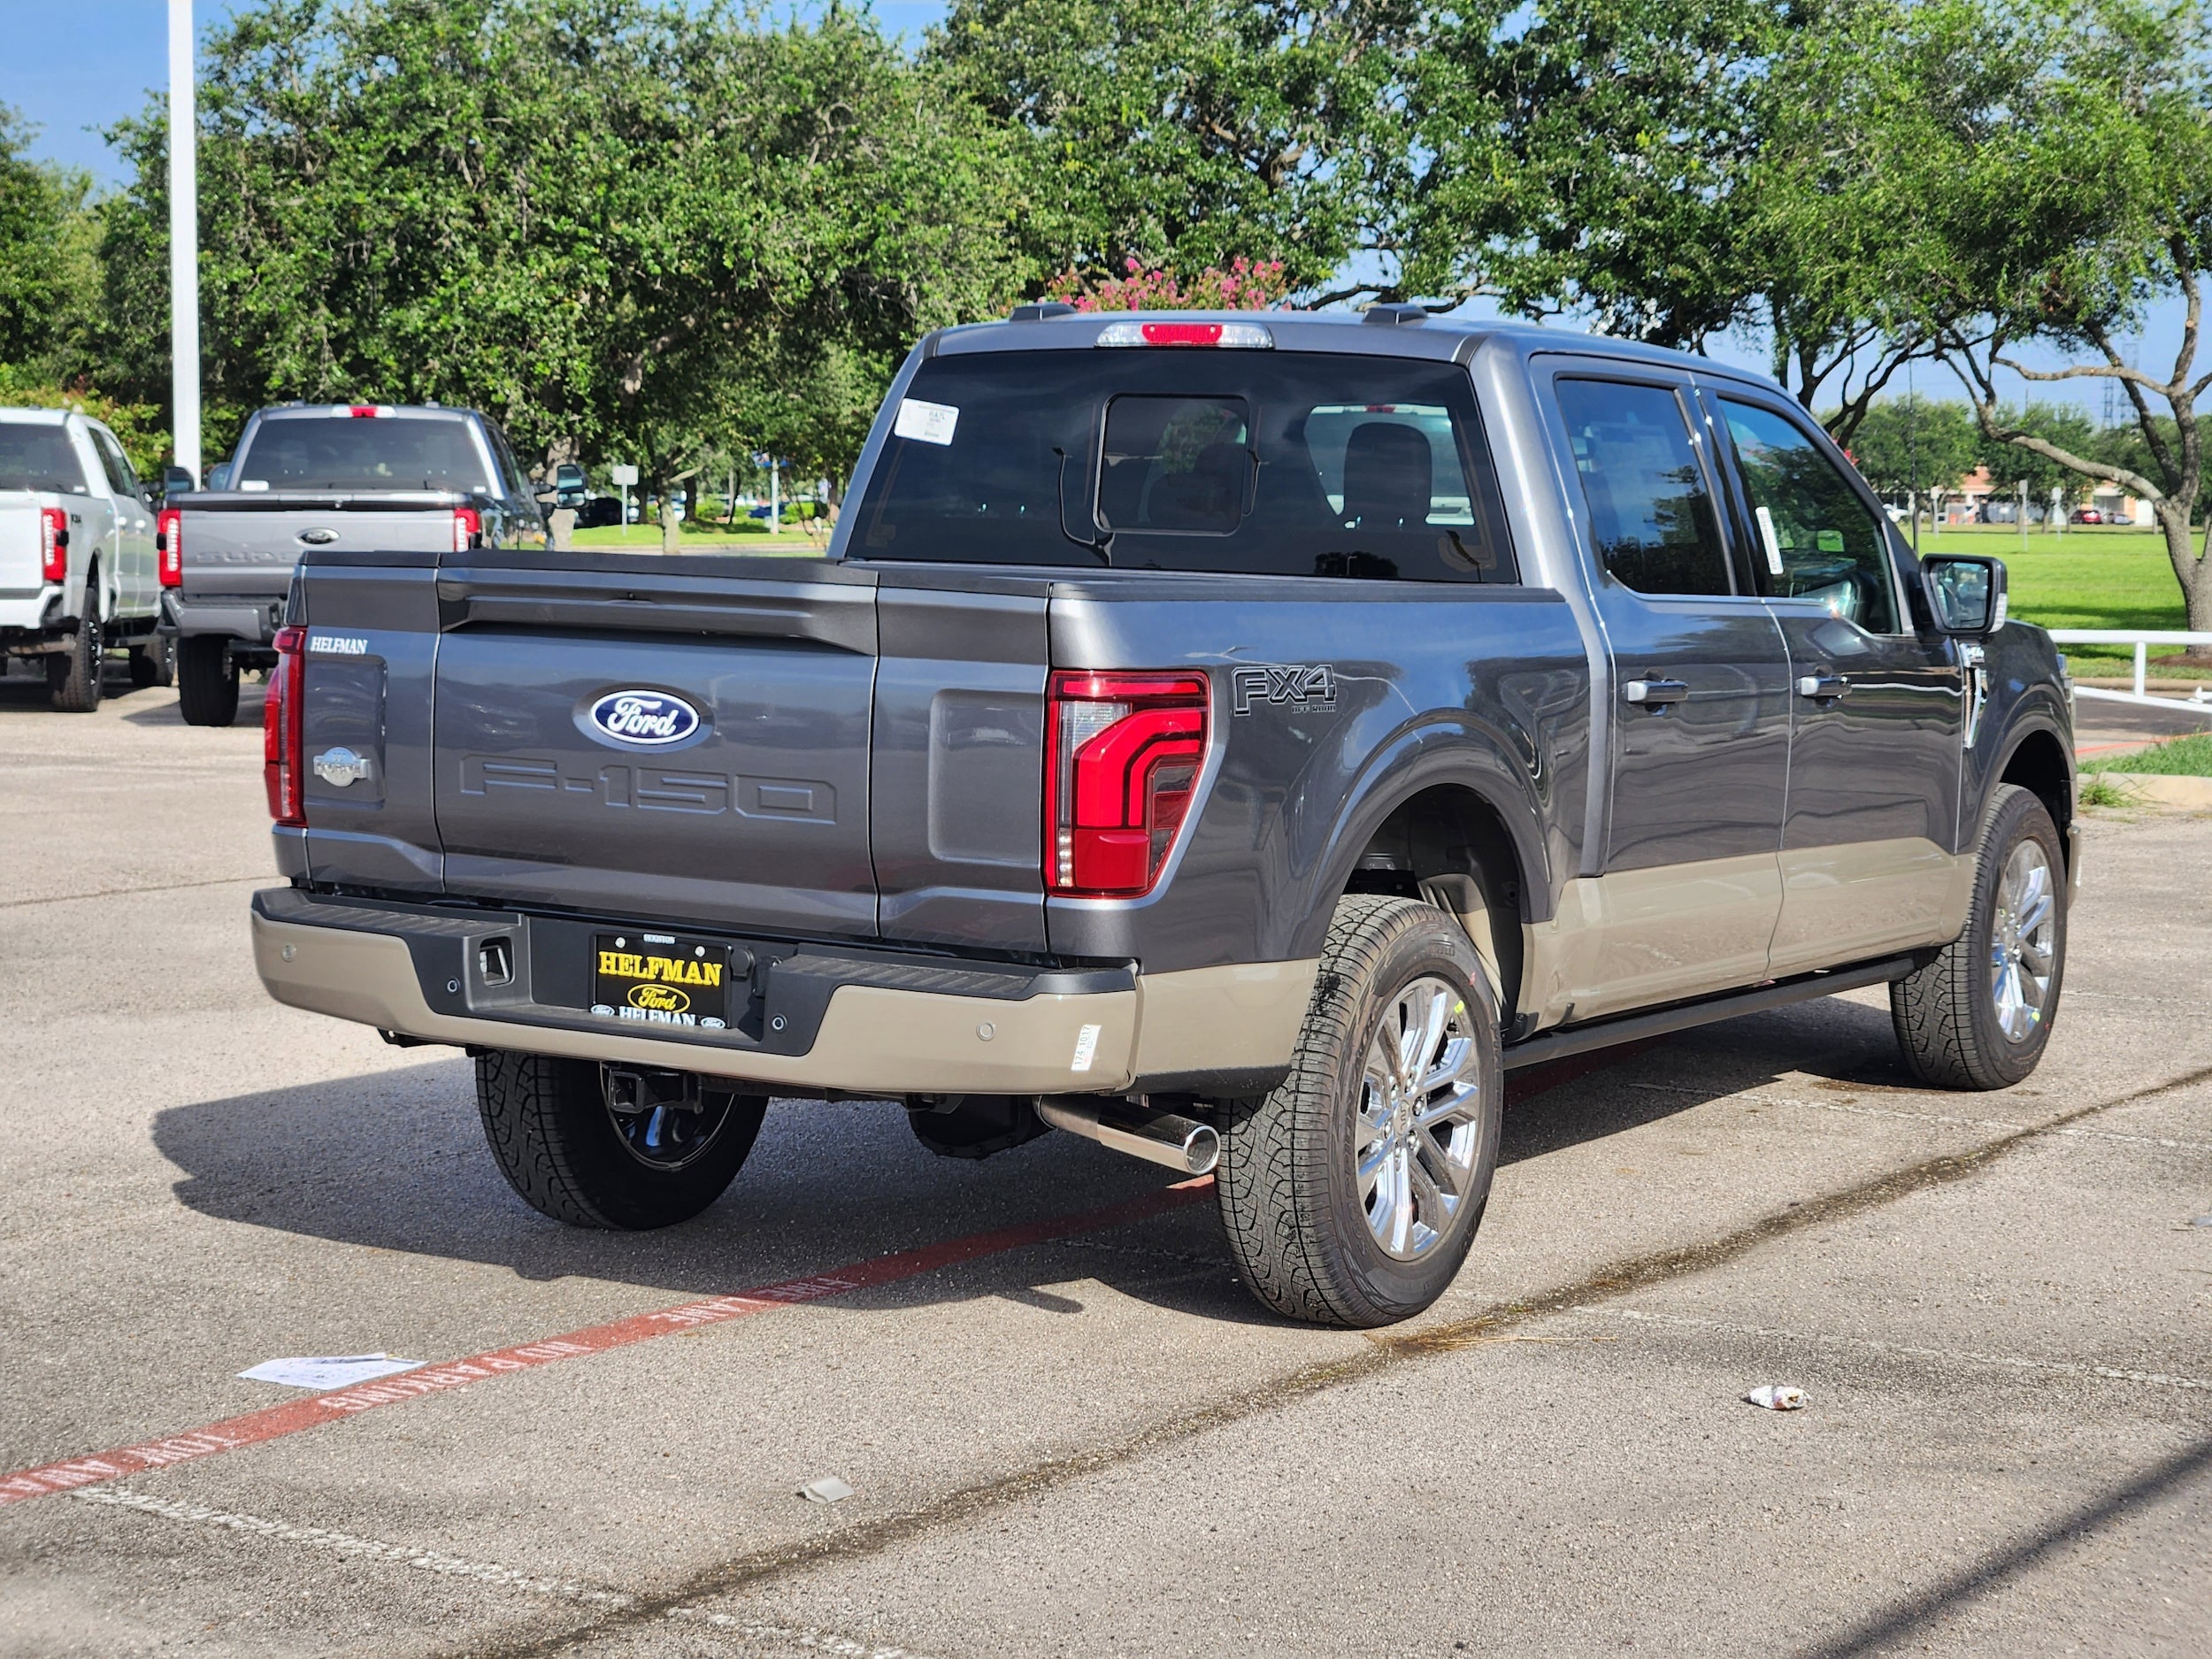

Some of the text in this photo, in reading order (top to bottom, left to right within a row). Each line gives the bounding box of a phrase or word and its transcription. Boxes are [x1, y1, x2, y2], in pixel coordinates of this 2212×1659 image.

[310, 635, 368, 655] HELFMAN
[1231, 664, 1338, 718] FX4
[606, 696, 678, 737] Ford
[458, 753, 838, 826] F-150
[598, 950, 723, 987] HELFMAN
[637, 987, 677, 1010] Ford
[618, 1005, 696, 1027] HELFMAN
[646, 1295, 773, 1325] LANE
[514, 1340, 595, 1359] NO
[317, 1356, 528, 1410] PARKING
